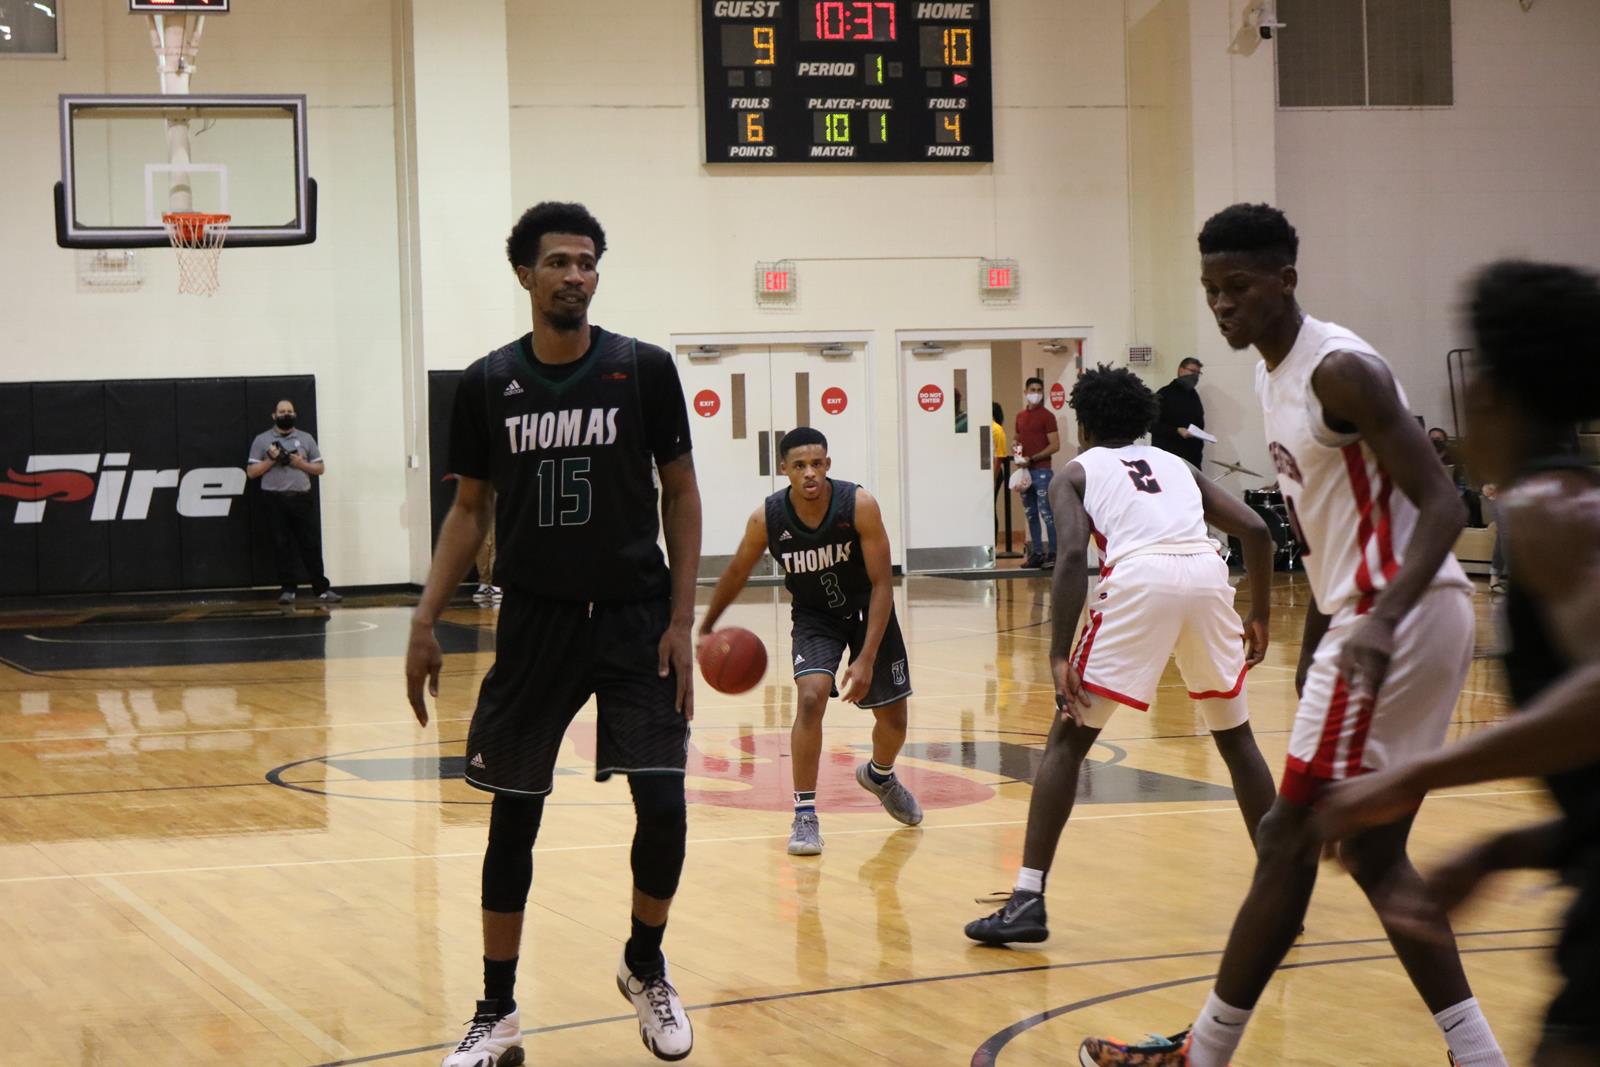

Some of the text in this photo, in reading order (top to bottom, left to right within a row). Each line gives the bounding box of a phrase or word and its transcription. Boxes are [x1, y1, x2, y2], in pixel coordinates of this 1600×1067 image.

[714, 1, 780, 17] GUEST
[815, 2, 896, 39] 10:37
[917, 3, 973, 19] HOME
[753, 27, 774, 65] 9
[943, 28, 972, 65] 10
[798, 55, 883, 84] PERIOD 1
[731, 98, 770, 109] FOULS
[808, 98, 892, 110] PLAYER-FOUL
[928, 98, 966, 109] FOULS
[746, 113, 764, 142] 6
[825, 113, 887, 142] 10 1
[944, 113, 961, 142] 4
[730, 146, 774, 157] POINTS
[810, 146, 854, 157] MATCH
[927, 145, 970, 157] POINTS
[765, 271, 788, 290] EXIT
[988, 268, 1011, 288] EXIT
[505, 407, 620, 454] THOMAS
[0, 453, 247, 523] Fire
[1120, 458, 1162, 494] 2
[537, 456, 592, 527] 15
[781, 540, 852, 574] THOMAS
[820, 571, 846, 609] 3
